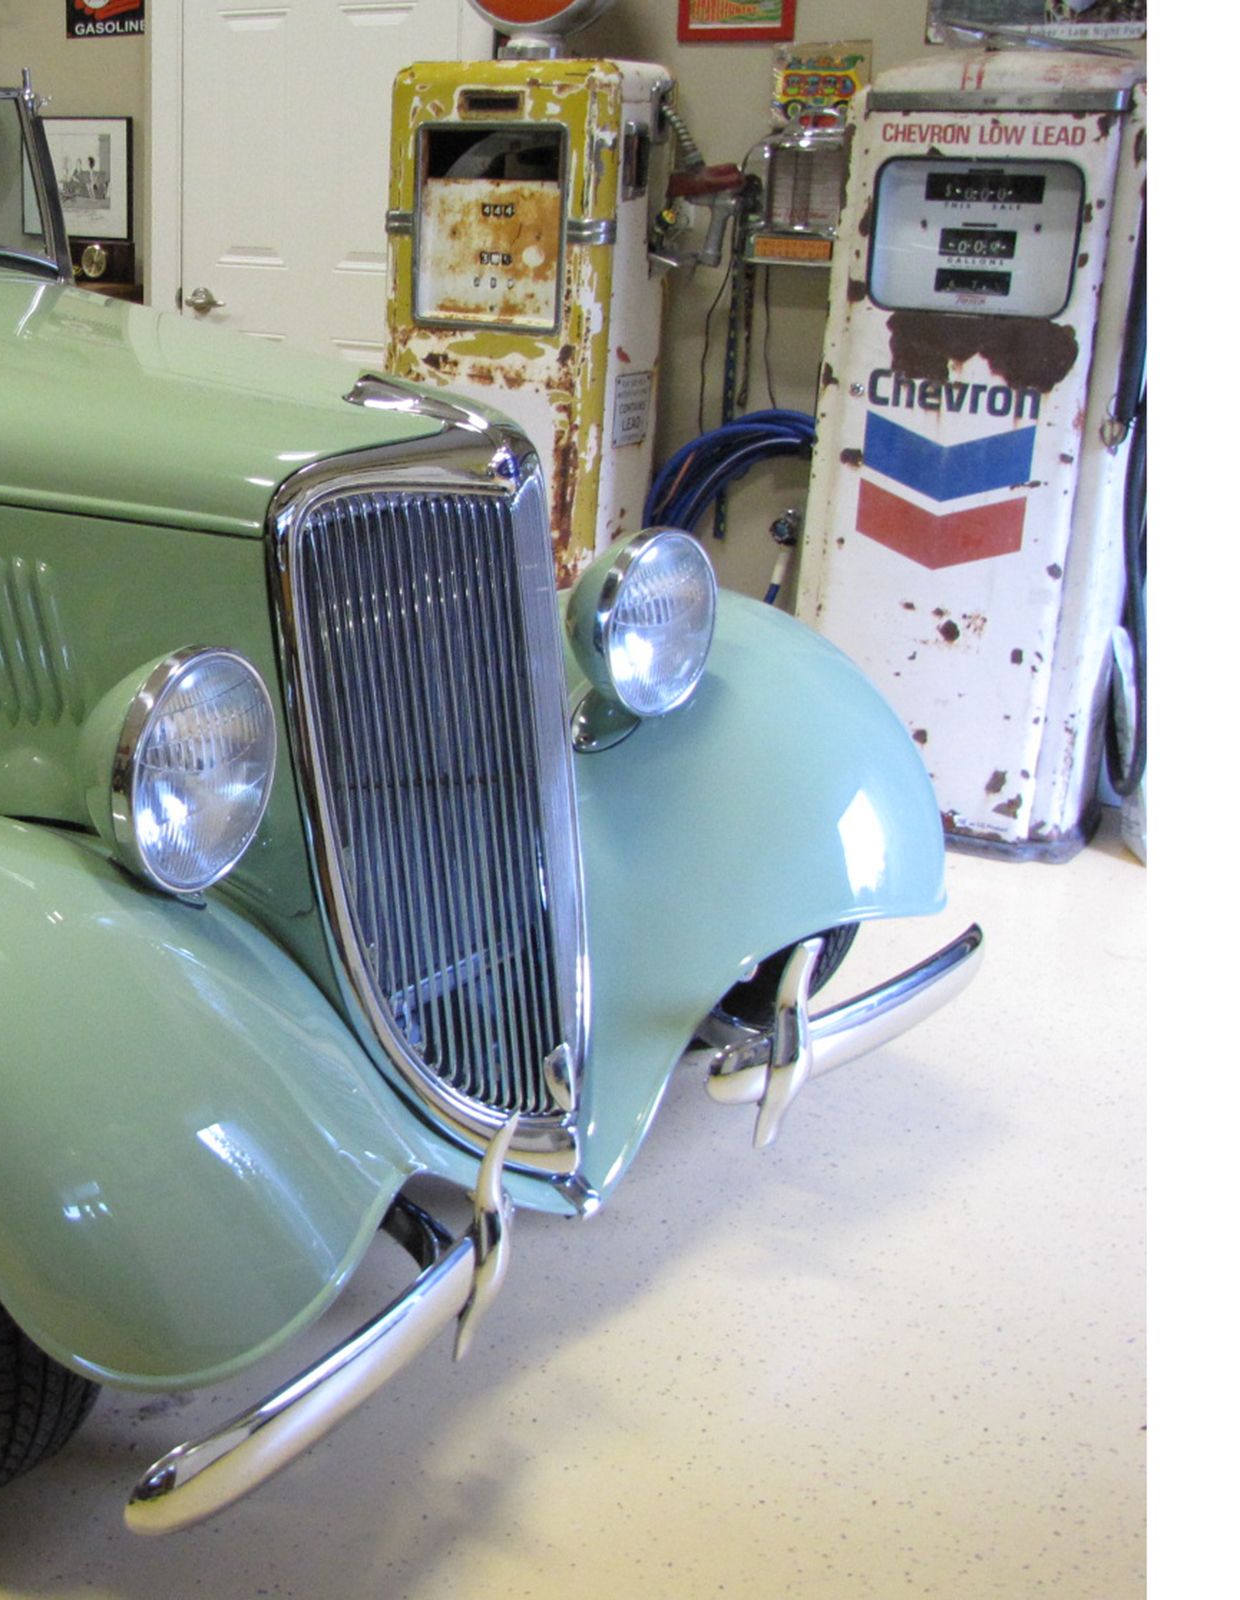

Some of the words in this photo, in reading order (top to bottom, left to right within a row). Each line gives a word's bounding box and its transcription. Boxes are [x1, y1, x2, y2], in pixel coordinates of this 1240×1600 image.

[881, 122, 971, 145] CHEVRON
[978, 124, 1027, 146] LOW
[1032, 125, 1086, 146] LEAD
[946, 257, 1005, 266] GALLONS
[868, 368, 1041, 420] Chevron
[622, 415, 641, 432] LEAD
